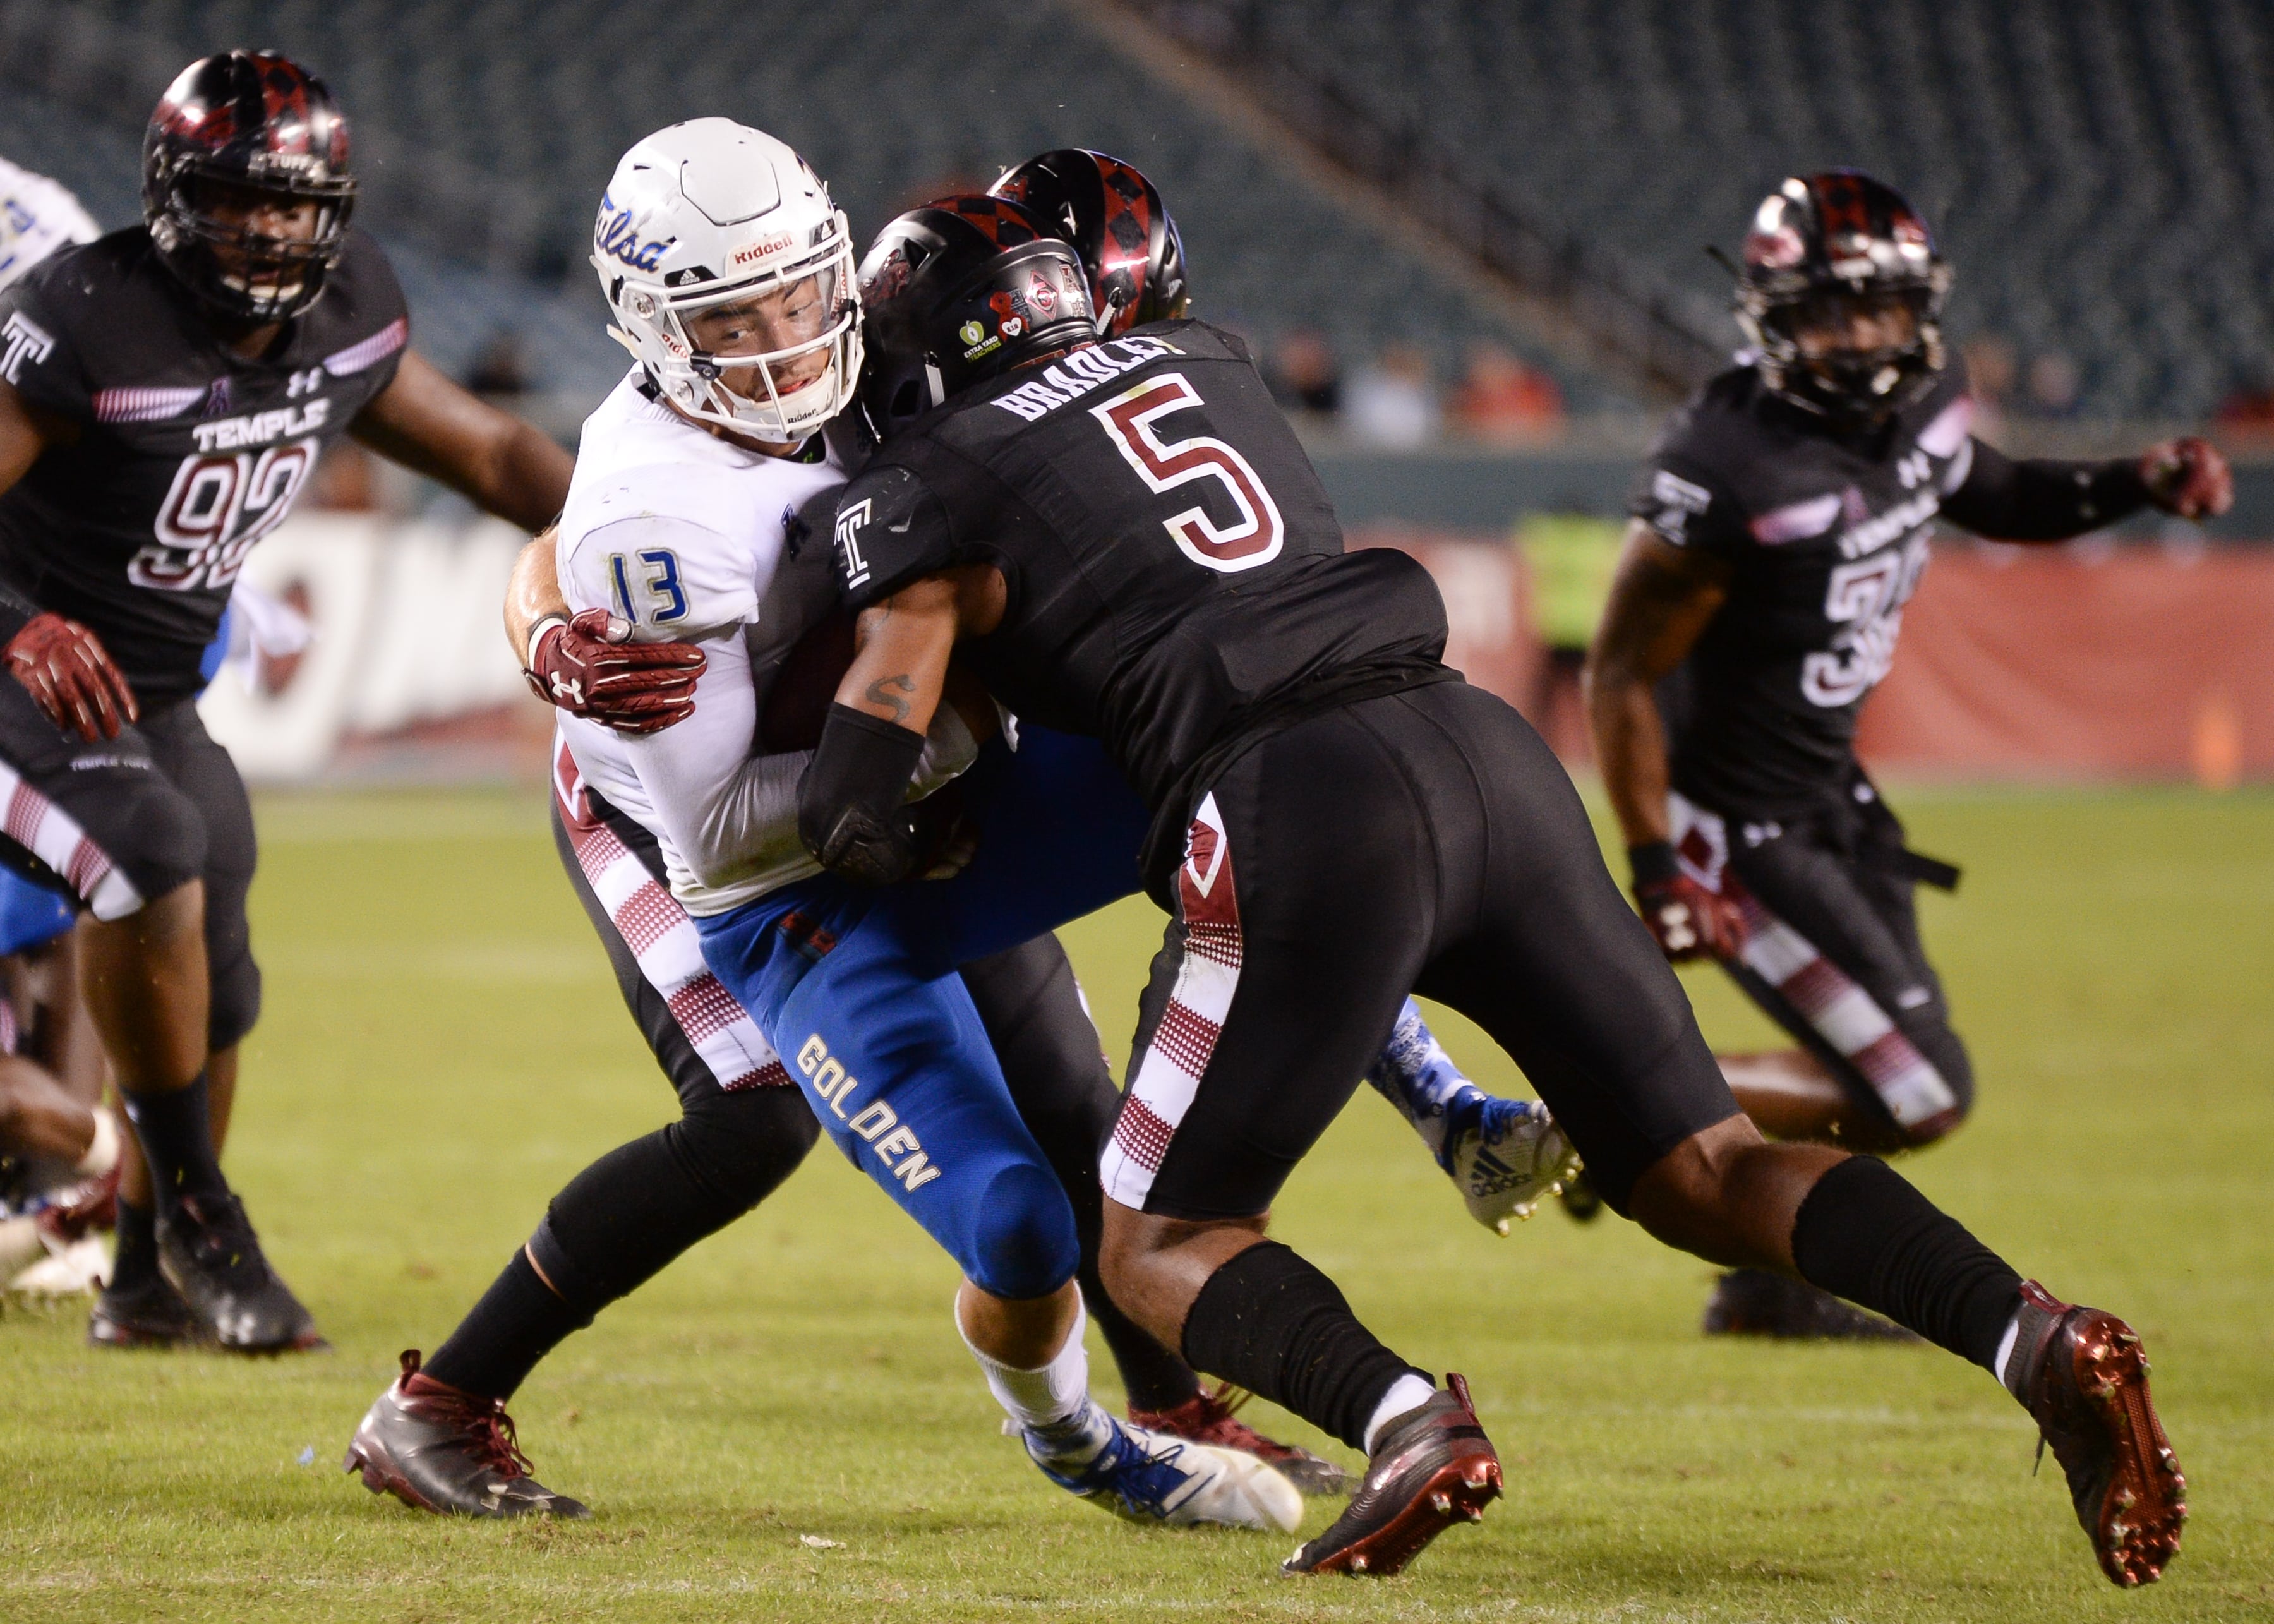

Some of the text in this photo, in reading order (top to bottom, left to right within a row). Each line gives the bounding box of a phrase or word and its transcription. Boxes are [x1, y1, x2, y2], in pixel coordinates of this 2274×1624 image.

[193, 397, 331, 452] TEMPLE
[1088, 373, 1284, 573] 5
[126, 436, 320, 591] 92
[834, 498, 872, 590] T
[609, 547, 690, 626] 13
[797, 1034, 940, 1193] GOLDEN
